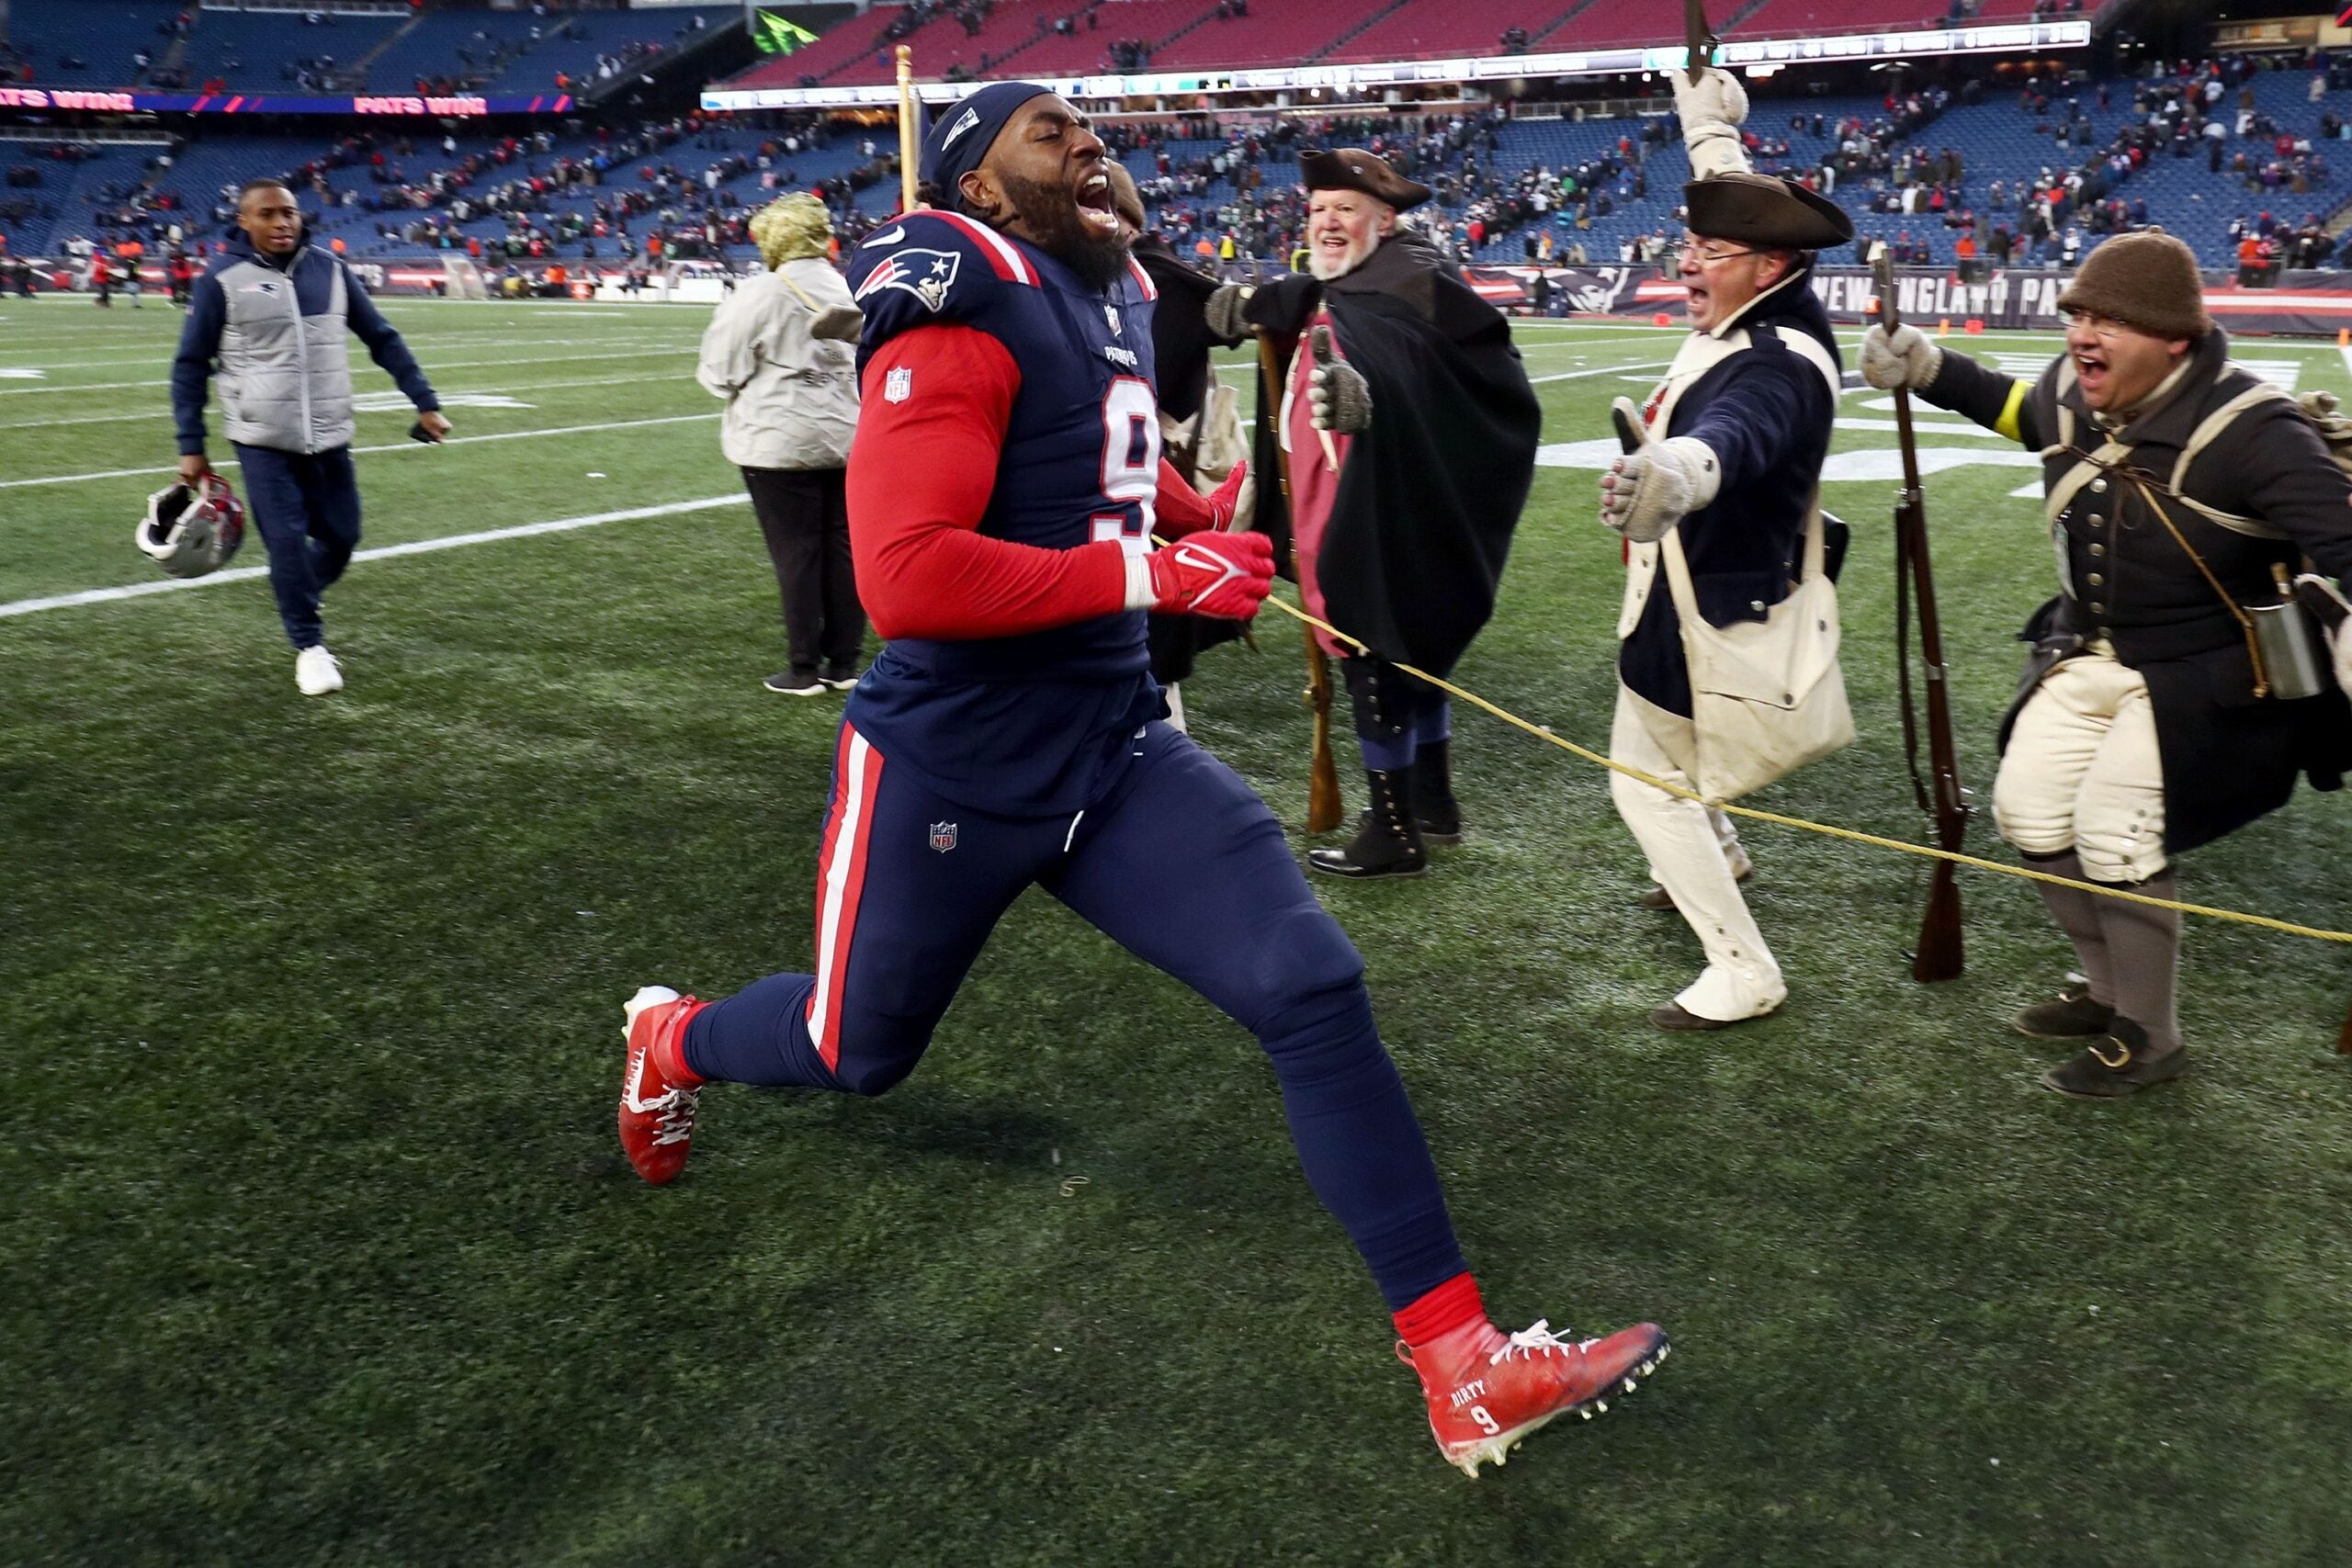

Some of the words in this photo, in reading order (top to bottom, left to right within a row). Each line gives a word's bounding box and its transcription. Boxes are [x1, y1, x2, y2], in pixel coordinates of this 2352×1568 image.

[353, 96, 425, 115] PATS
[1811, 276, 1873, 311] NEW
[1891, 277, 2009, 315] NGLAND
[1089, 375, 1159, 553] 9
[1451, 1379, 1486, 1407] DIRTY
[1470, 1404, 1500, 1435] 9
